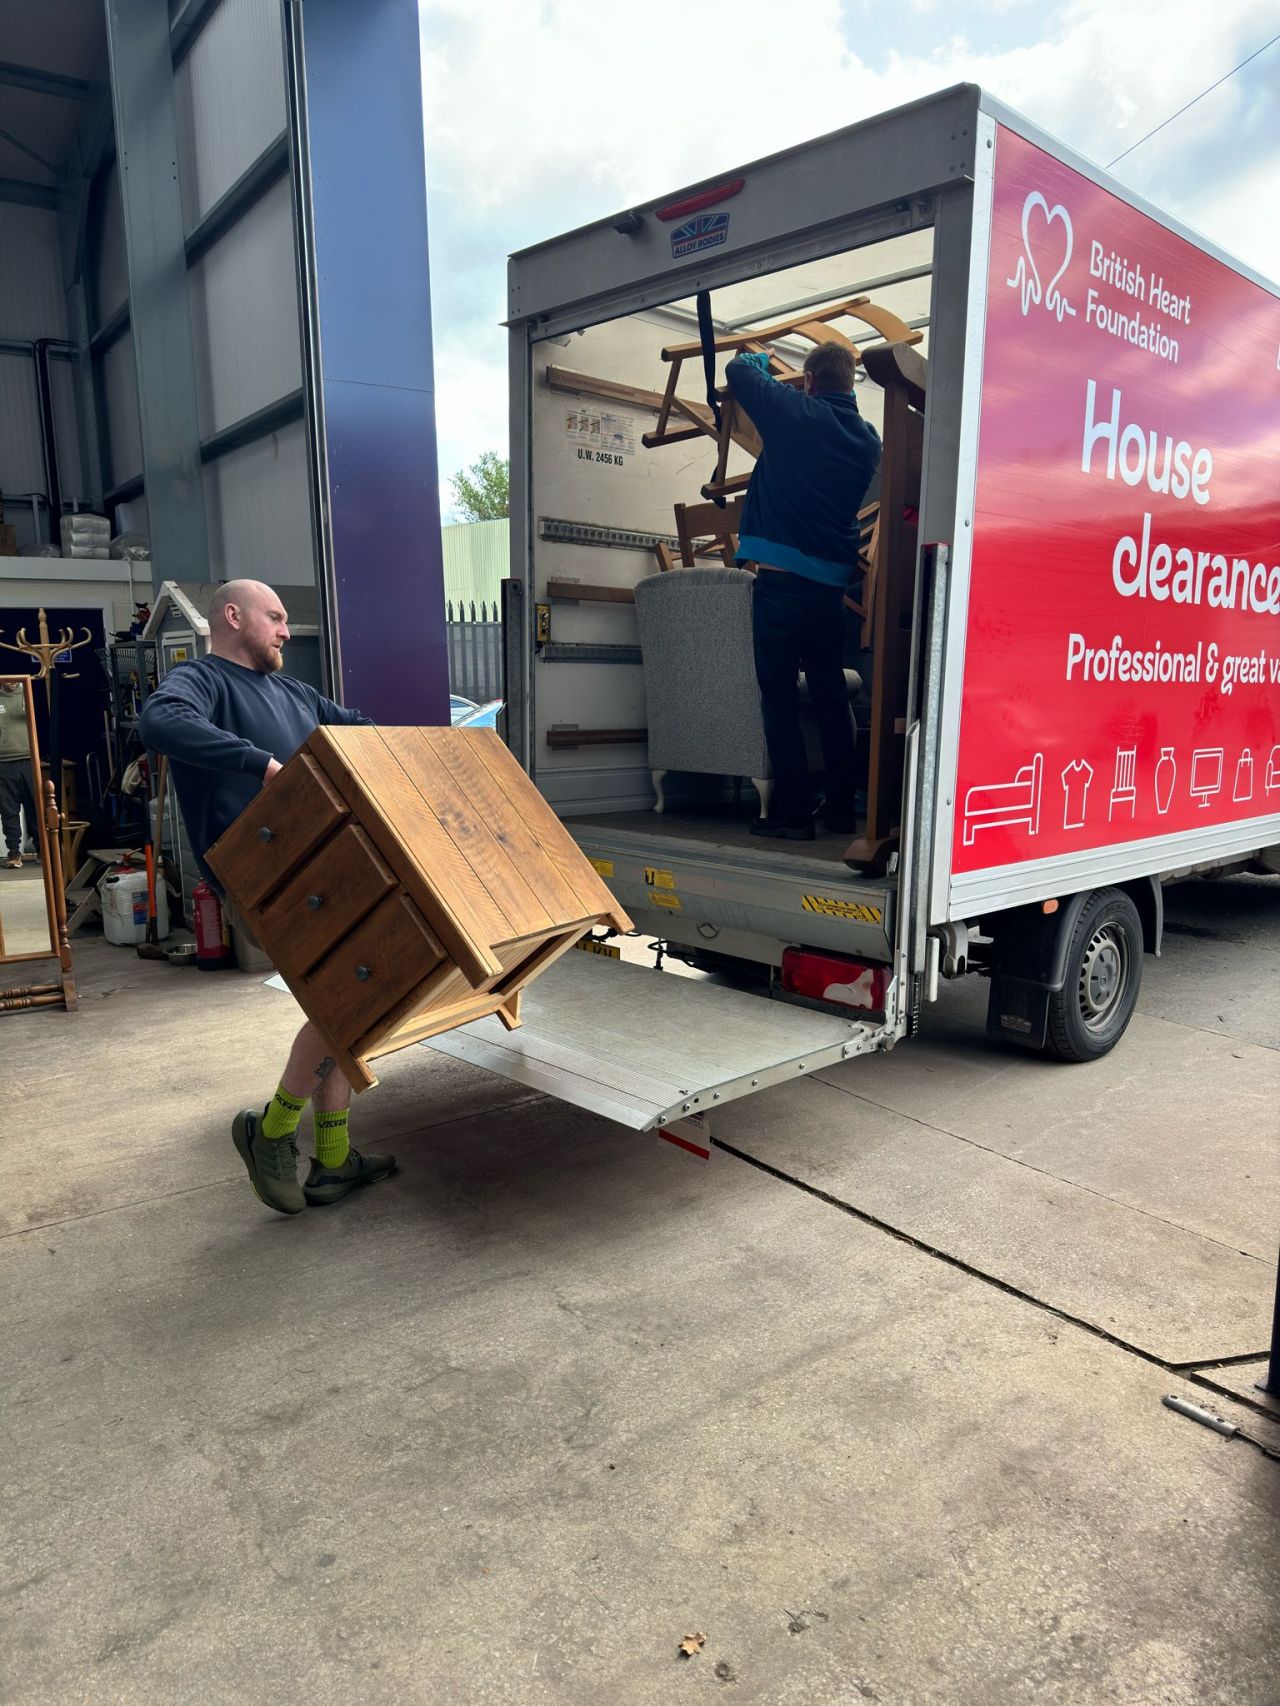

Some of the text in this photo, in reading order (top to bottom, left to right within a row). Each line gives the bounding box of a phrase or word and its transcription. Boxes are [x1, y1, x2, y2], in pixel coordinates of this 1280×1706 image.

[676, 233, 724, 255] ALLOY BODIES
[1089, 239, 1191, 325] British Heart
[1085, 288, 1180, 363] Foundation
[578, 448, 623, 466] U.W. 2456 KG
[1081, 378, 1214, 505] House
[1112, 511, 1280, 615] clearance
[1065, 632, 1202, 683] Professional
[1205, 642, 1219, 683] &
[1220, 650, 1266, 696] great
